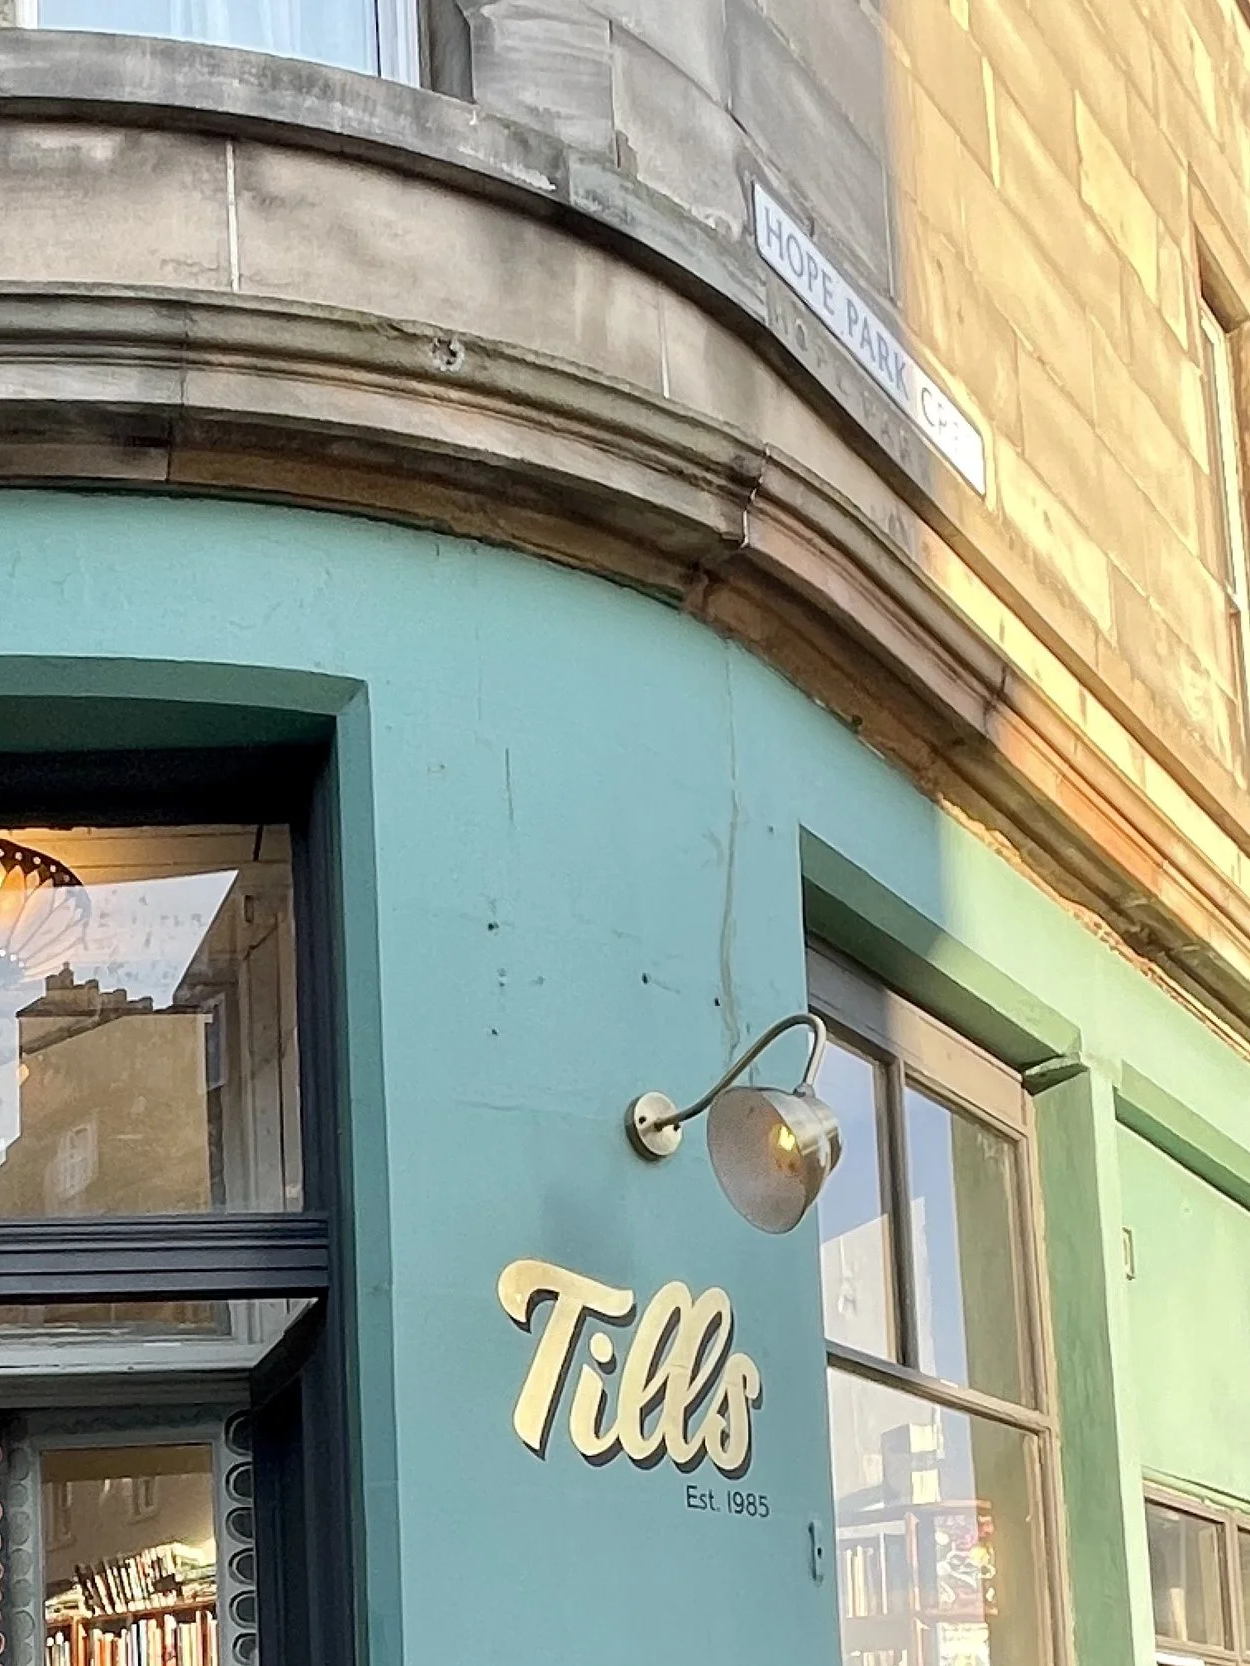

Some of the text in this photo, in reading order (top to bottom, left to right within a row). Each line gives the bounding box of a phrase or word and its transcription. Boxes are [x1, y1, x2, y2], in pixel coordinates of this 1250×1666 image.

[763, 205, 837, 317] HOPE
[845, 297, 911, 402] PARK
[496, 1257, 763, 1481] Tills
[686, 1484, 771, 1519] Est. 1985
